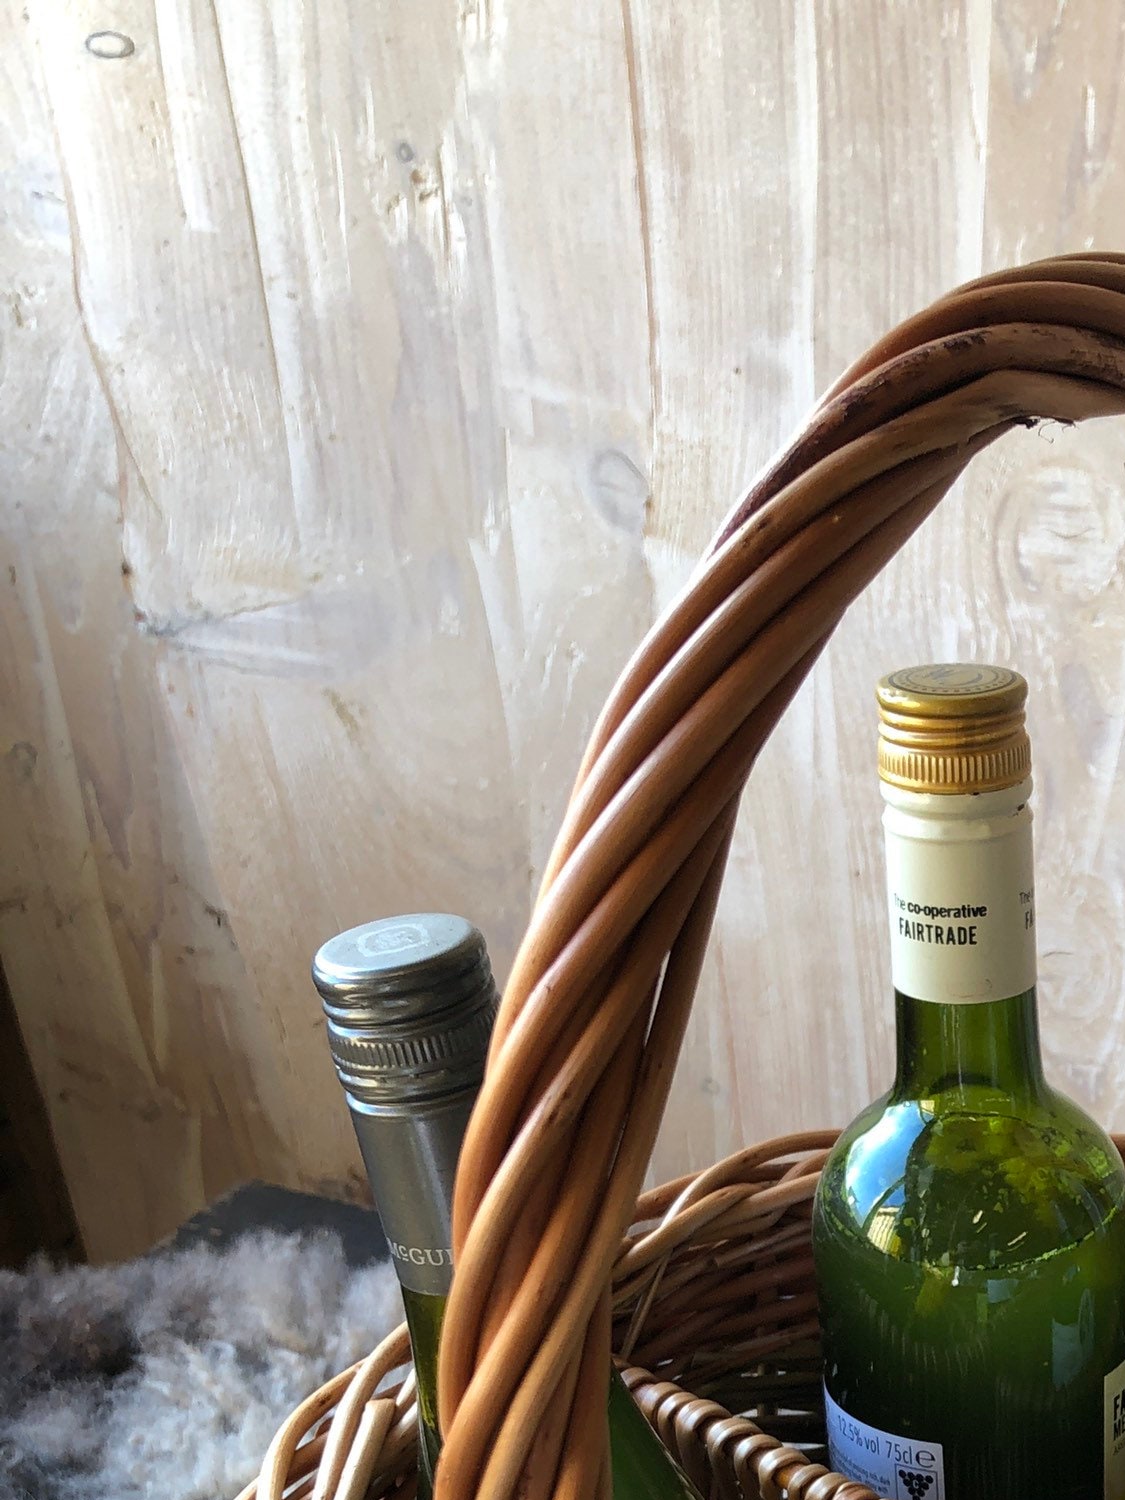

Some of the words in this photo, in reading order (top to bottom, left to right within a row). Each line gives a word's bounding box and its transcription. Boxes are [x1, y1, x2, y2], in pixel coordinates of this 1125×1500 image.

[907, 901, 987, 920] co-operative
[899, 916, 978, 946] FAIRTRADE
[864, 1437, 880, 1456] vol
